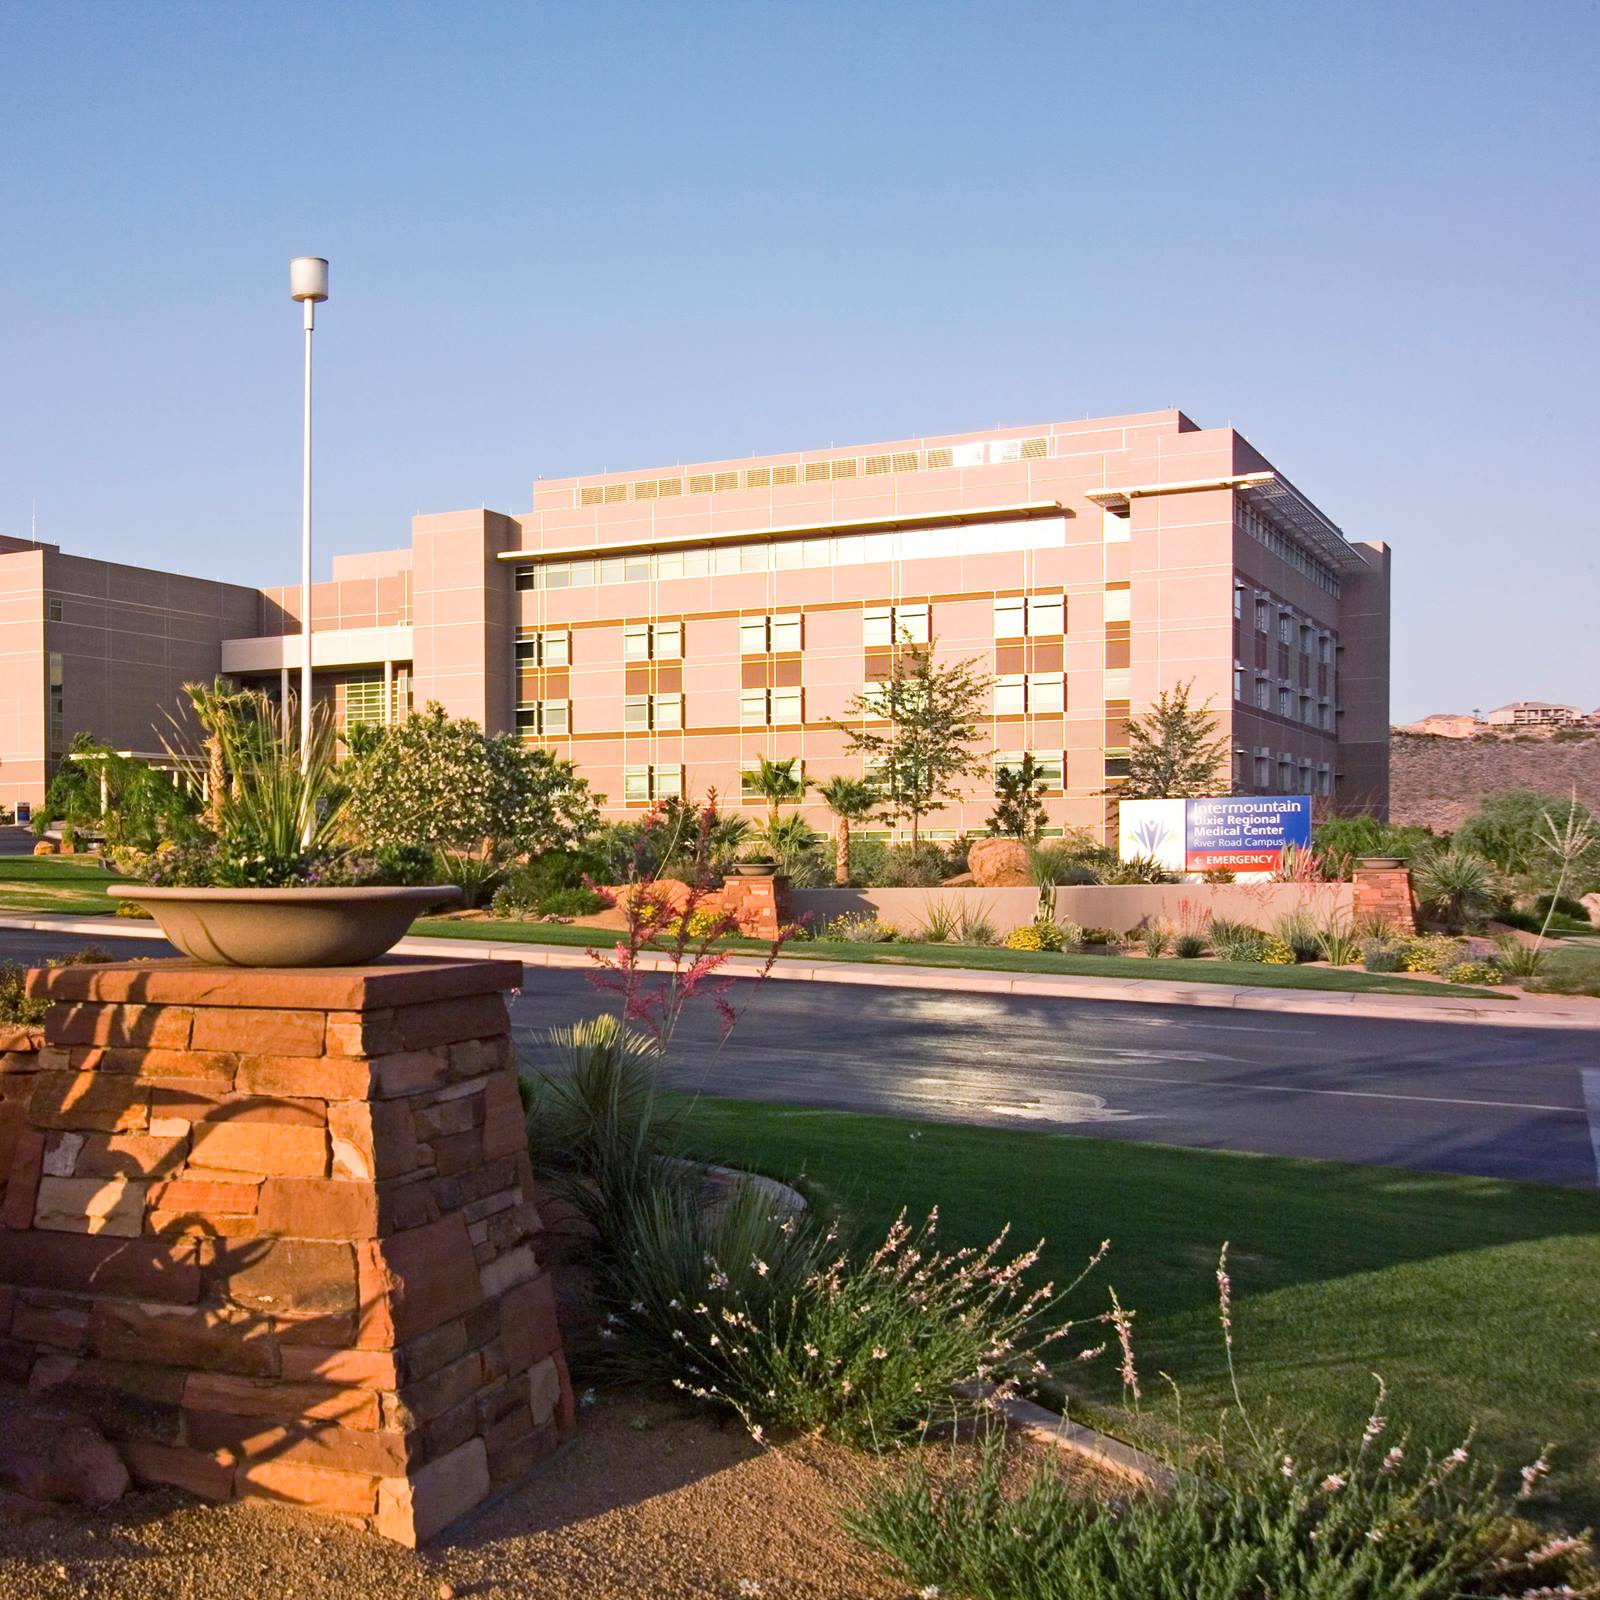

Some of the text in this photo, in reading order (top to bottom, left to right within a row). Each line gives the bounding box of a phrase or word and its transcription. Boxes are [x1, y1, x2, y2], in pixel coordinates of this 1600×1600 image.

[1227, 814, 1280, 827] Regional
[1194, 826, 1284, 836] Medical Center
[1193, 837, 1283, 848] River Road Campus
[1206, 855, 1273, 864] EMERGENCY
